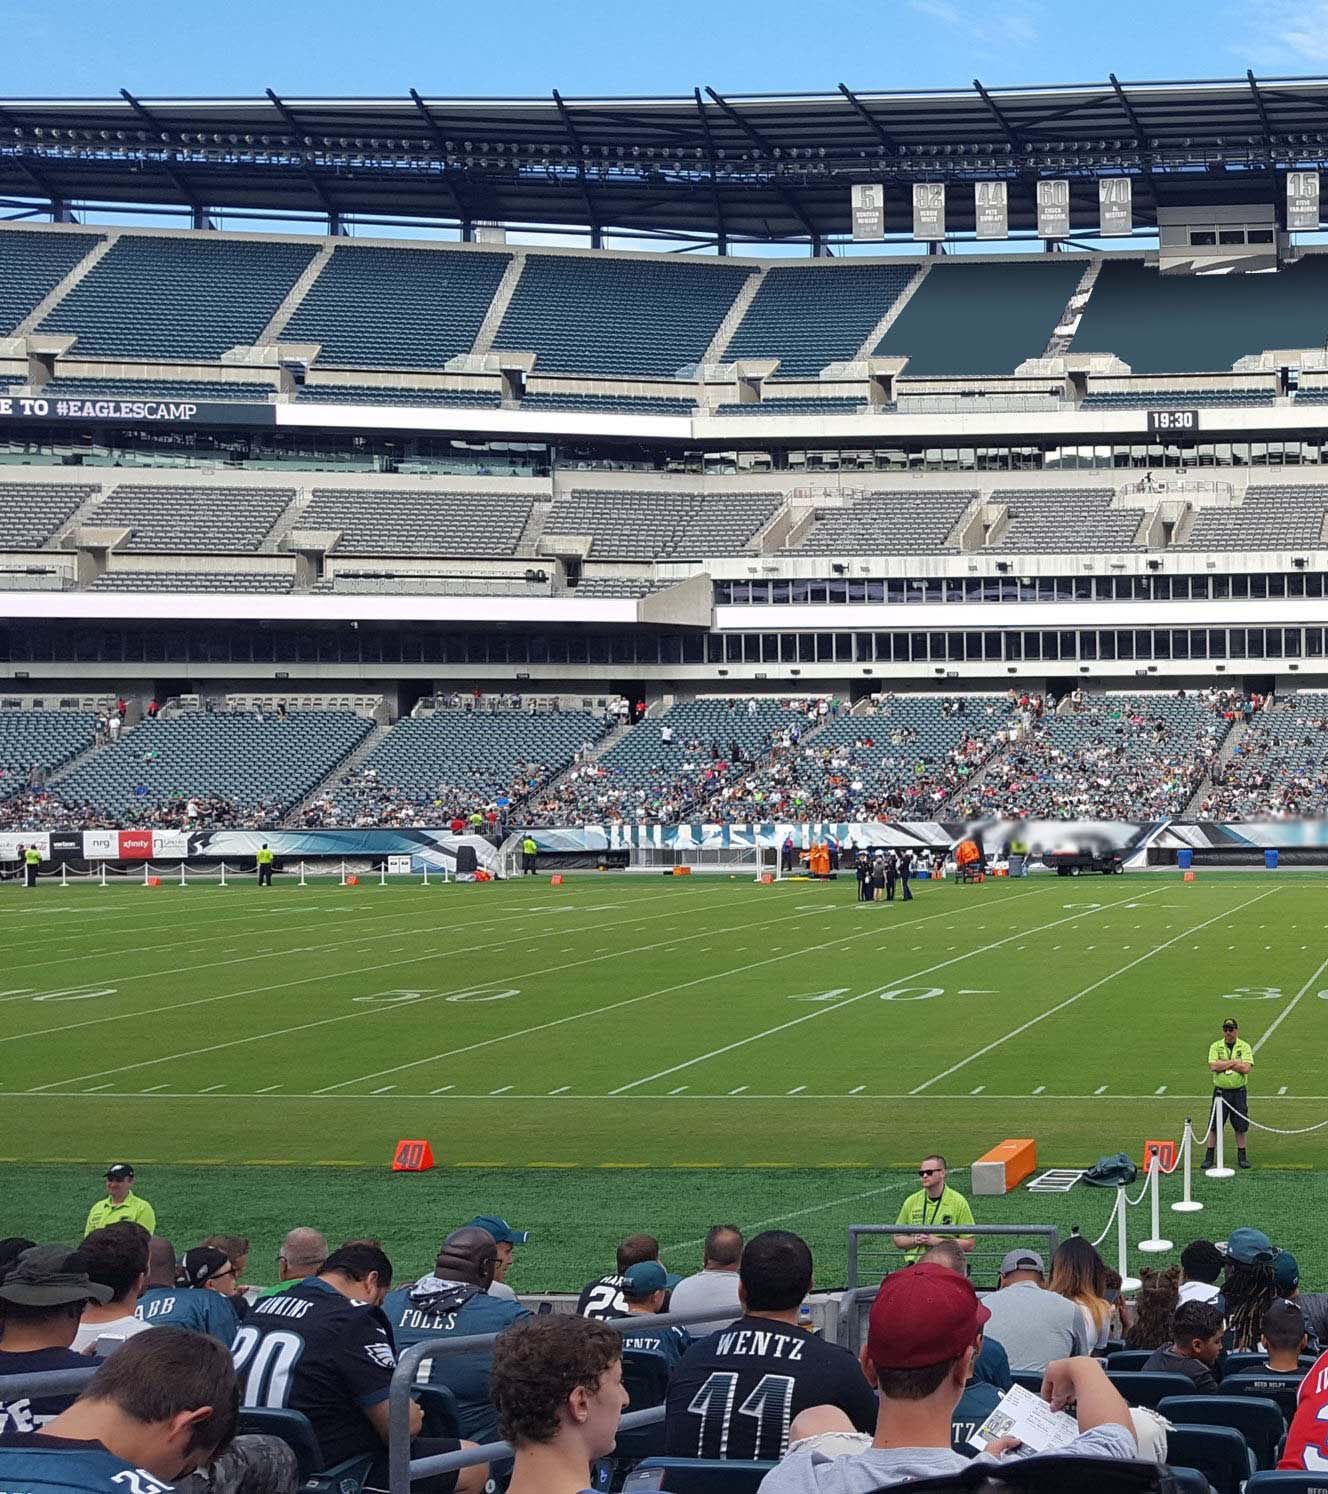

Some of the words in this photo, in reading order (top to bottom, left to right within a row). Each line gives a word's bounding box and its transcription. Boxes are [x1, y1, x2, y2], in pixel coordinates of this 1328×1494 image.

[861, 186, 874, 209] 5
[915, 185, 943, 208] 92
[978, 183, 1006, 207] 44
[1039, 182, 1067, 206] 60
[1101, 180, 1129, 204] 70
[1290, 174, 1316, 199] 15
[20, 400, 49, 416] TO
[56, 400, 197, 420] #EAGLESCAMP
[1153, 412, 1193, 428] 19:30
[93, 839, 110, 849] nrg
[123, 839, 149, 849] xfinity
[396, 1143, 423, 1169] 40
[399, 1308, 458, 1330] FOLES
[622, 1338, 661, 1351] ENTZ
[715, 1330, 806, 1361] WENTZ
